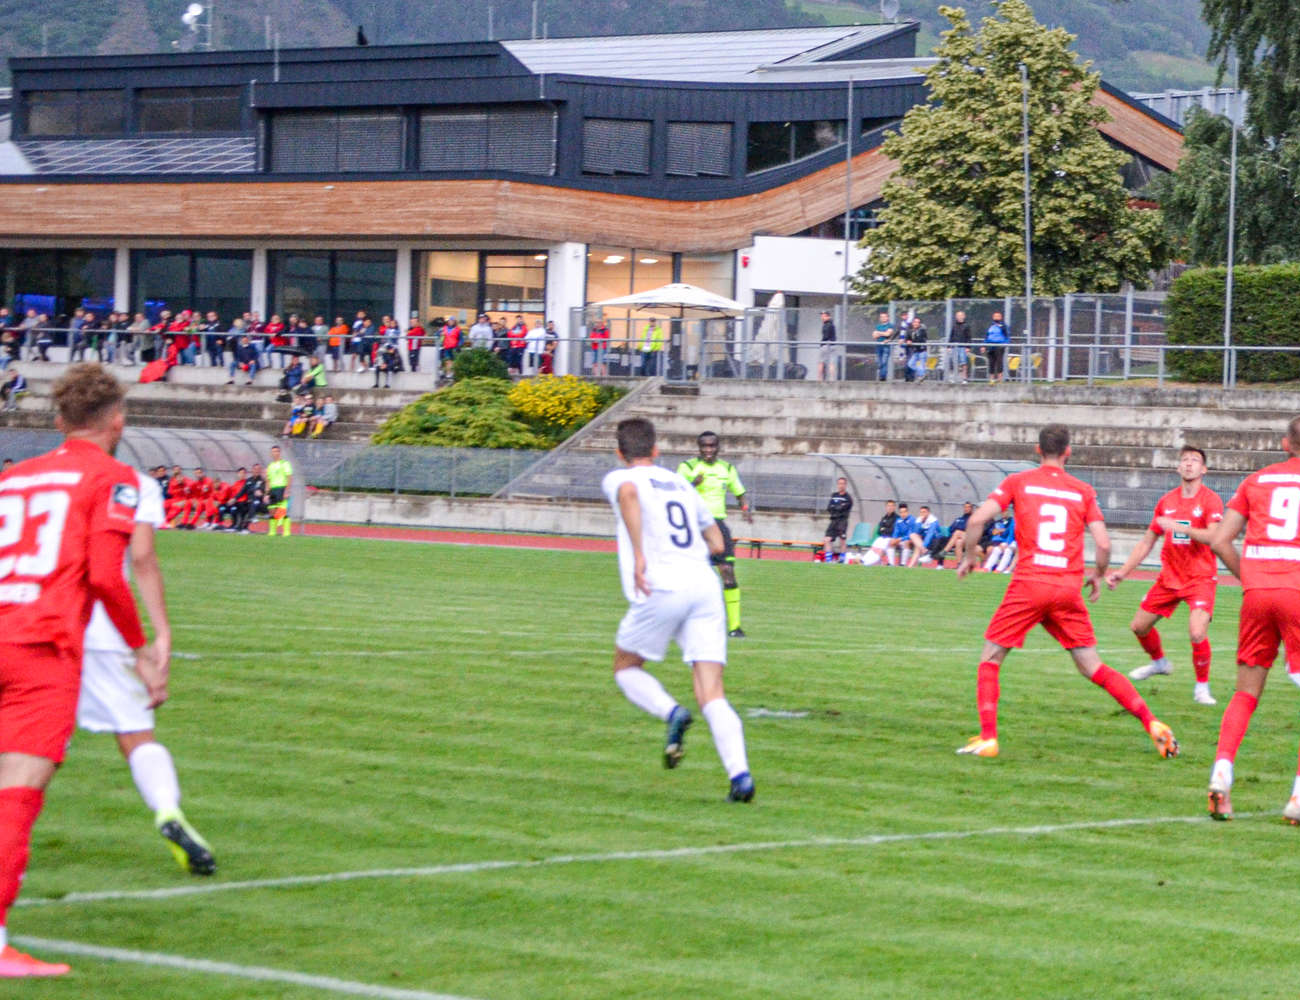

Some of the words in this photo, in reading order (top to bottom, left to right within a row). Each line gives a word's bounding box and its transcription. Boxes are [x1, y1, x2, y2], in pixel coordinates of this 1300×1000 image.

[0, 491, 71, 578] 23
[665, 501, 693, 549] 9
[1037, 502, 1068, 552] 2
